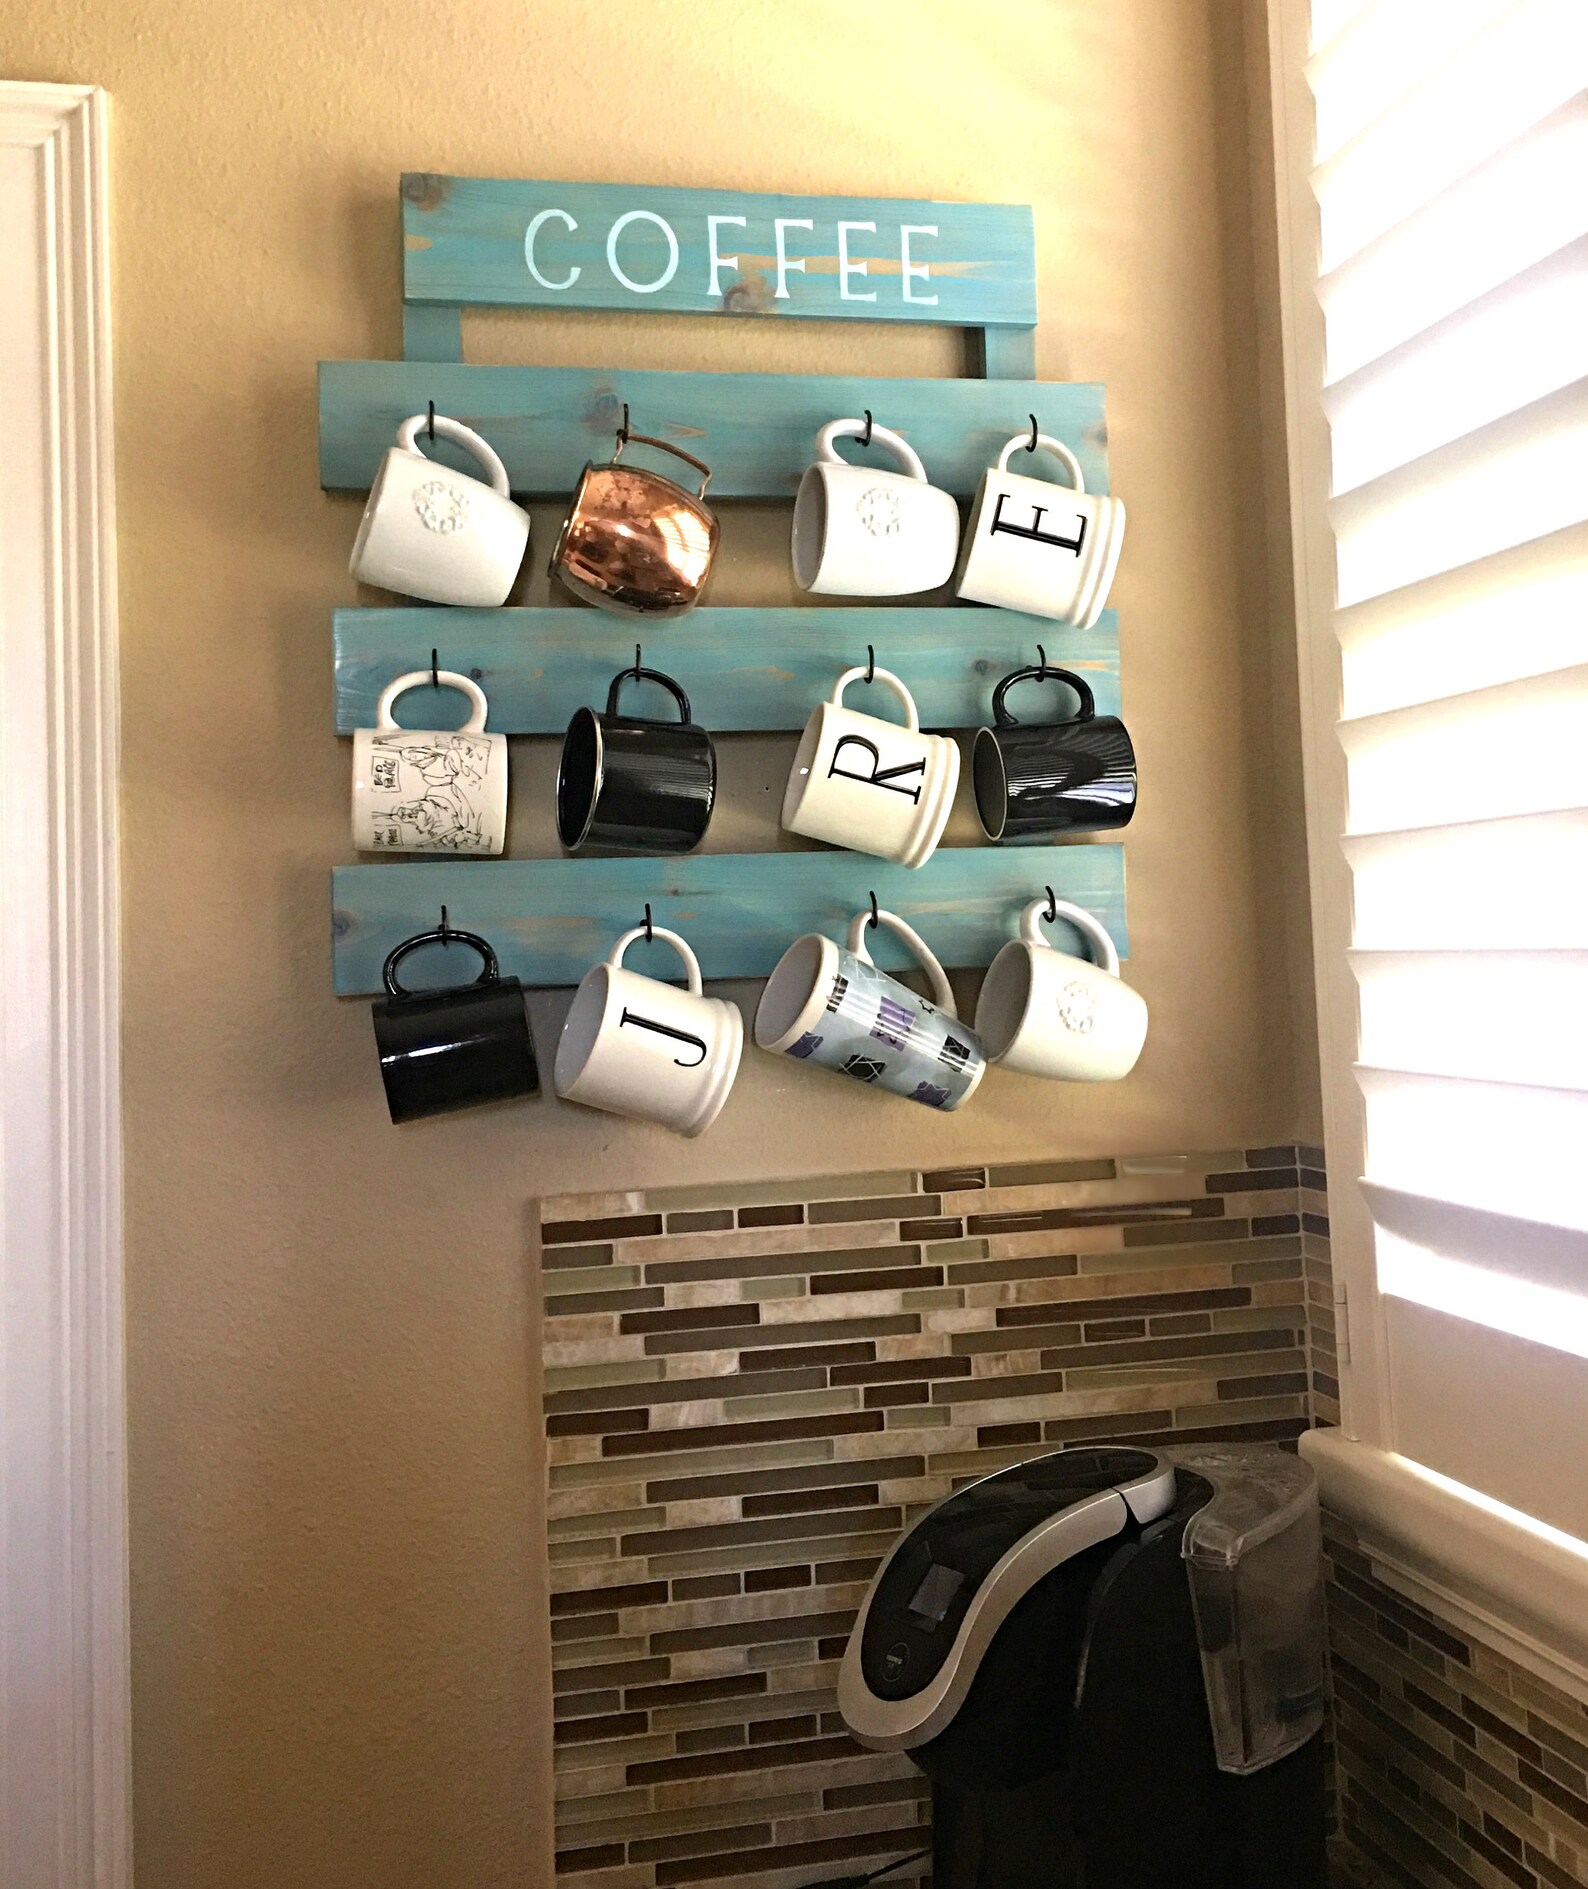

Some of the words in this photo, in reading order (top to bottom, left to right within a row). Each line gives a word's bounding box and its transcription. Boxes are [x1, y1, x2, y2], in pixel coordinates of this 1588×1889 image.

[524, 208, 939, 305] COFFEE
[990, 493, 1088, 558] E
[827, 734, 927, 805] R
[619, 1006, 707, 1067] J
